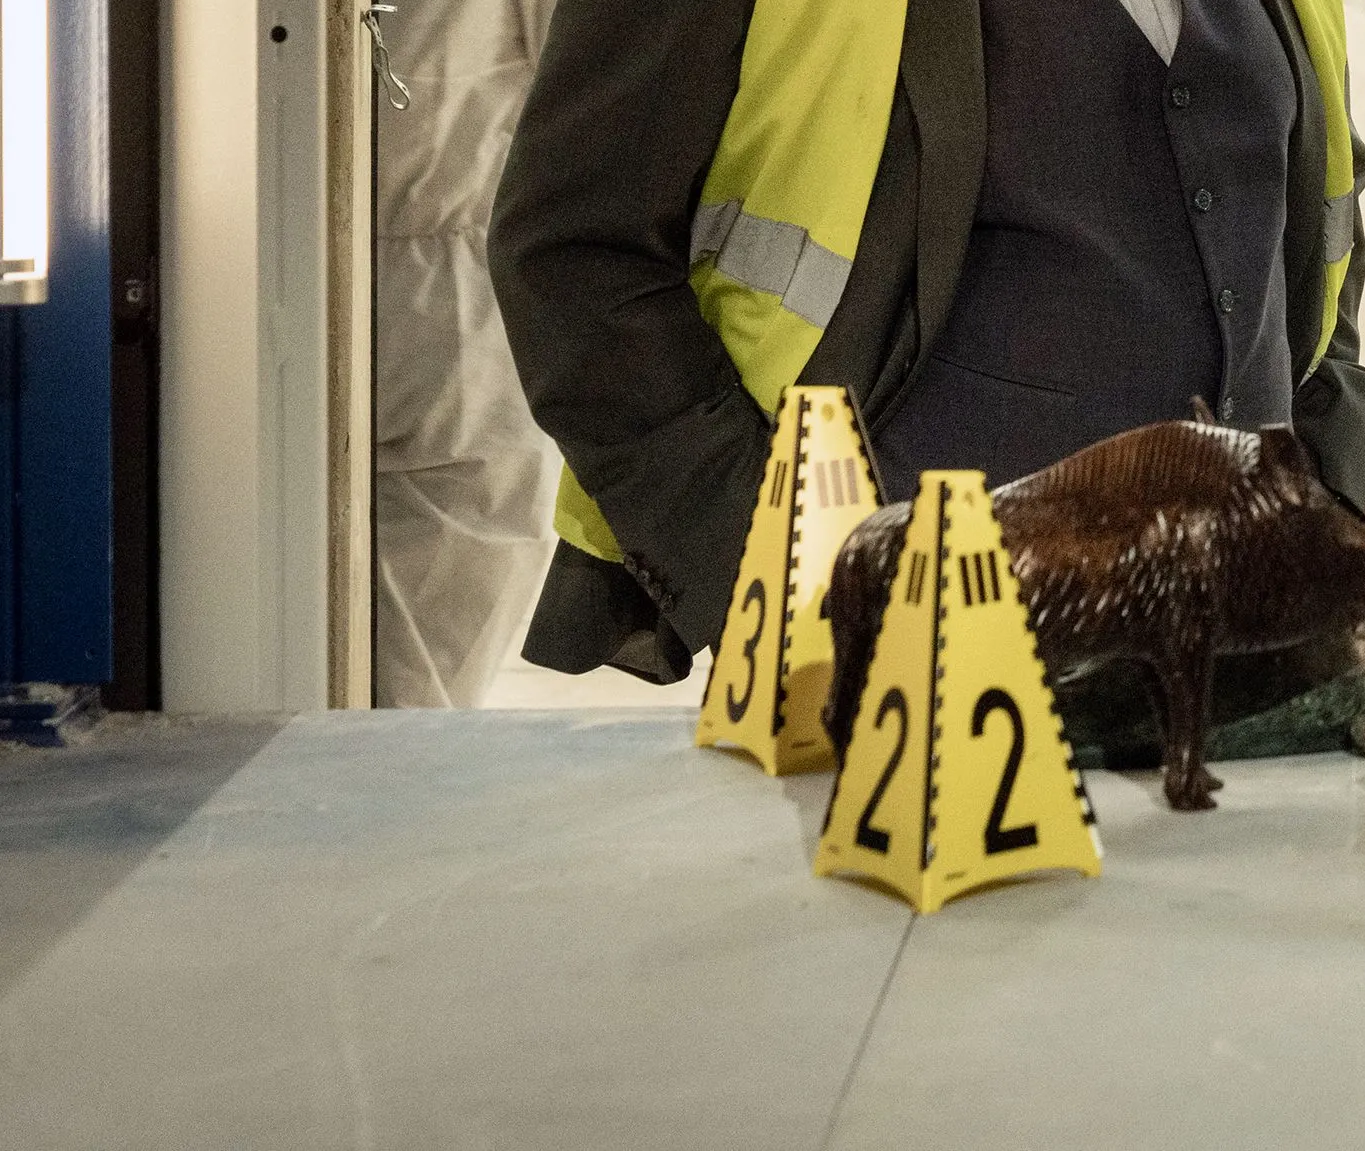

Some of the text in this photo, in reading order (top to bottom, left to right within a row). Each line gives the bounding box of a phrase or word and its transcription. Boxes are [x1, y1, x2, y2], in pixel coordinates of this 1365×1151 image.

[726, 577, 767, 726] 3
[855, 686, 908, 854] 2
[971, 688, 1040, 855] 2
